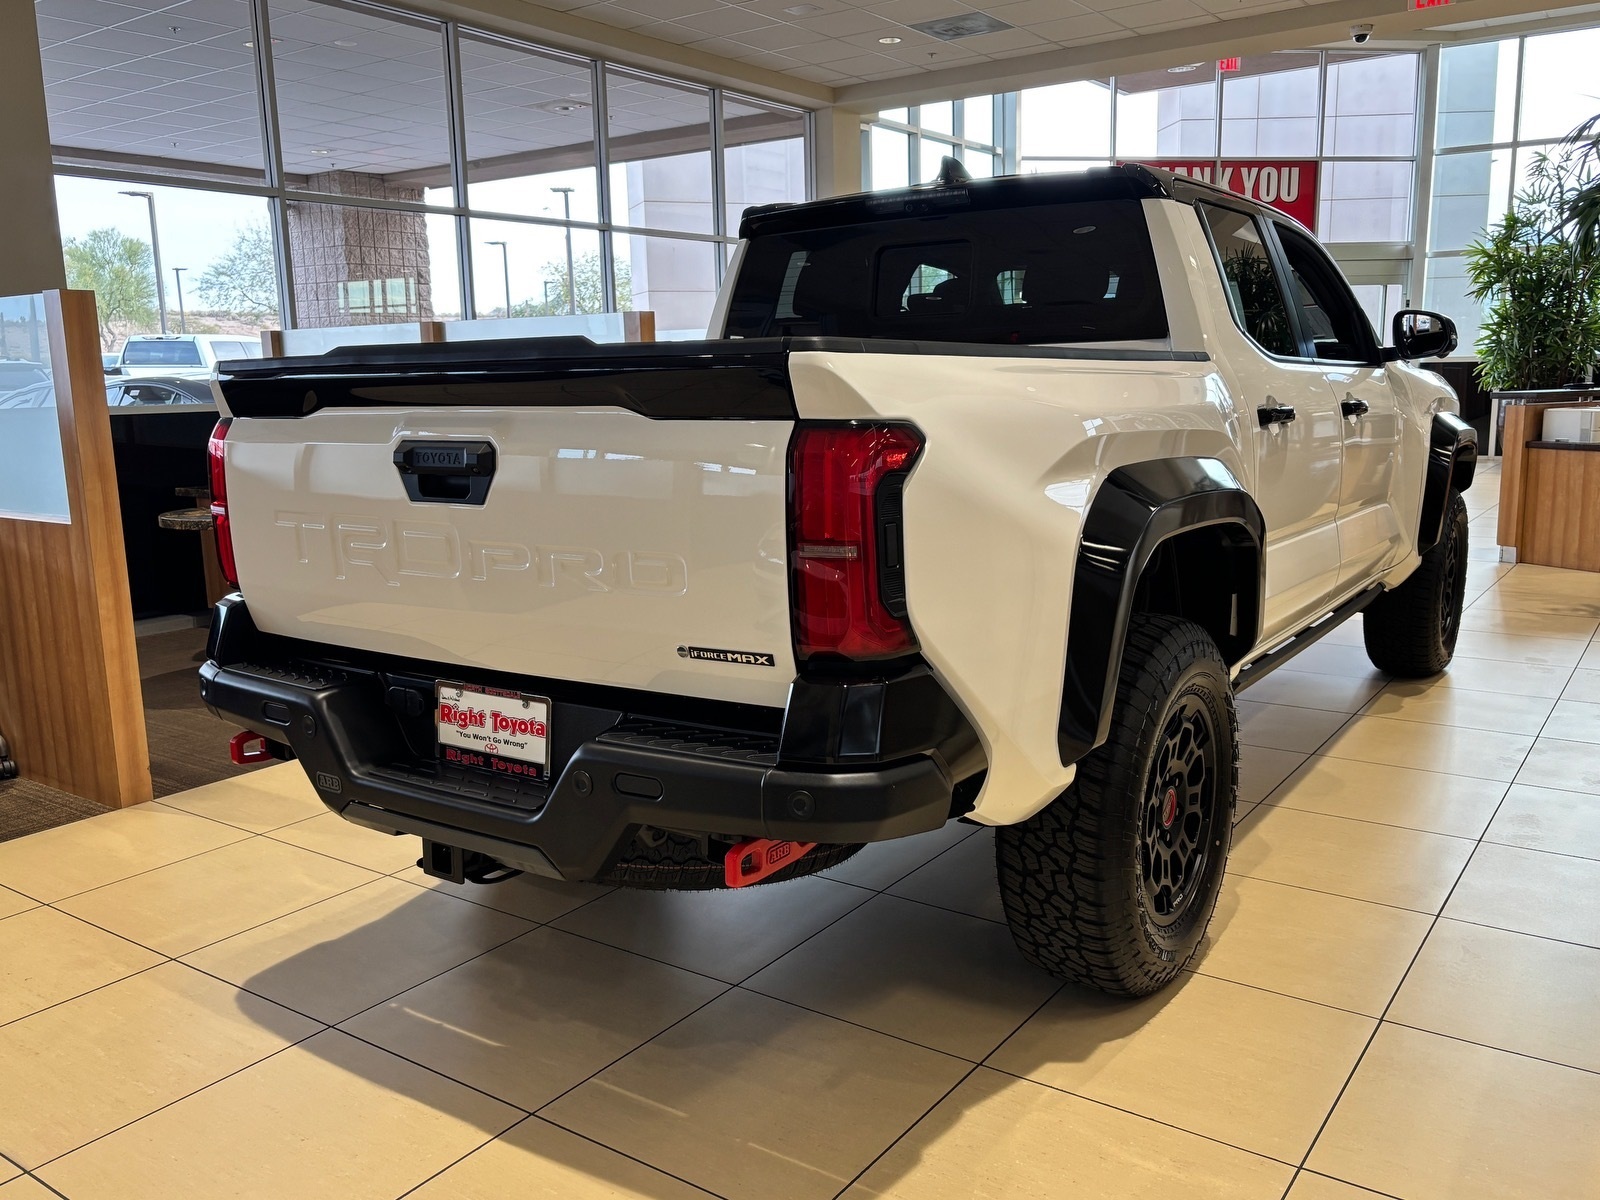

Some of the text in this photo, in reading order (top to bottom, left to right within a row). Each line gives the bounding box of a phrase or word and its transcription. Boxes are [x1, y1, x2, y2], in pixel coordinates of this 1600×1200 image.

[1241, 167, 1300, 203] YOU
[415, 452, 461, 465] TOYOTA
[439, 702, 546, 738] Right Toyota
[472, 733, 491, 743] Won't
[446, 748, 537, 777] Right Toyota
[319, 775, 340, 791] ARB
[769, 843, 791, 864] ARB
